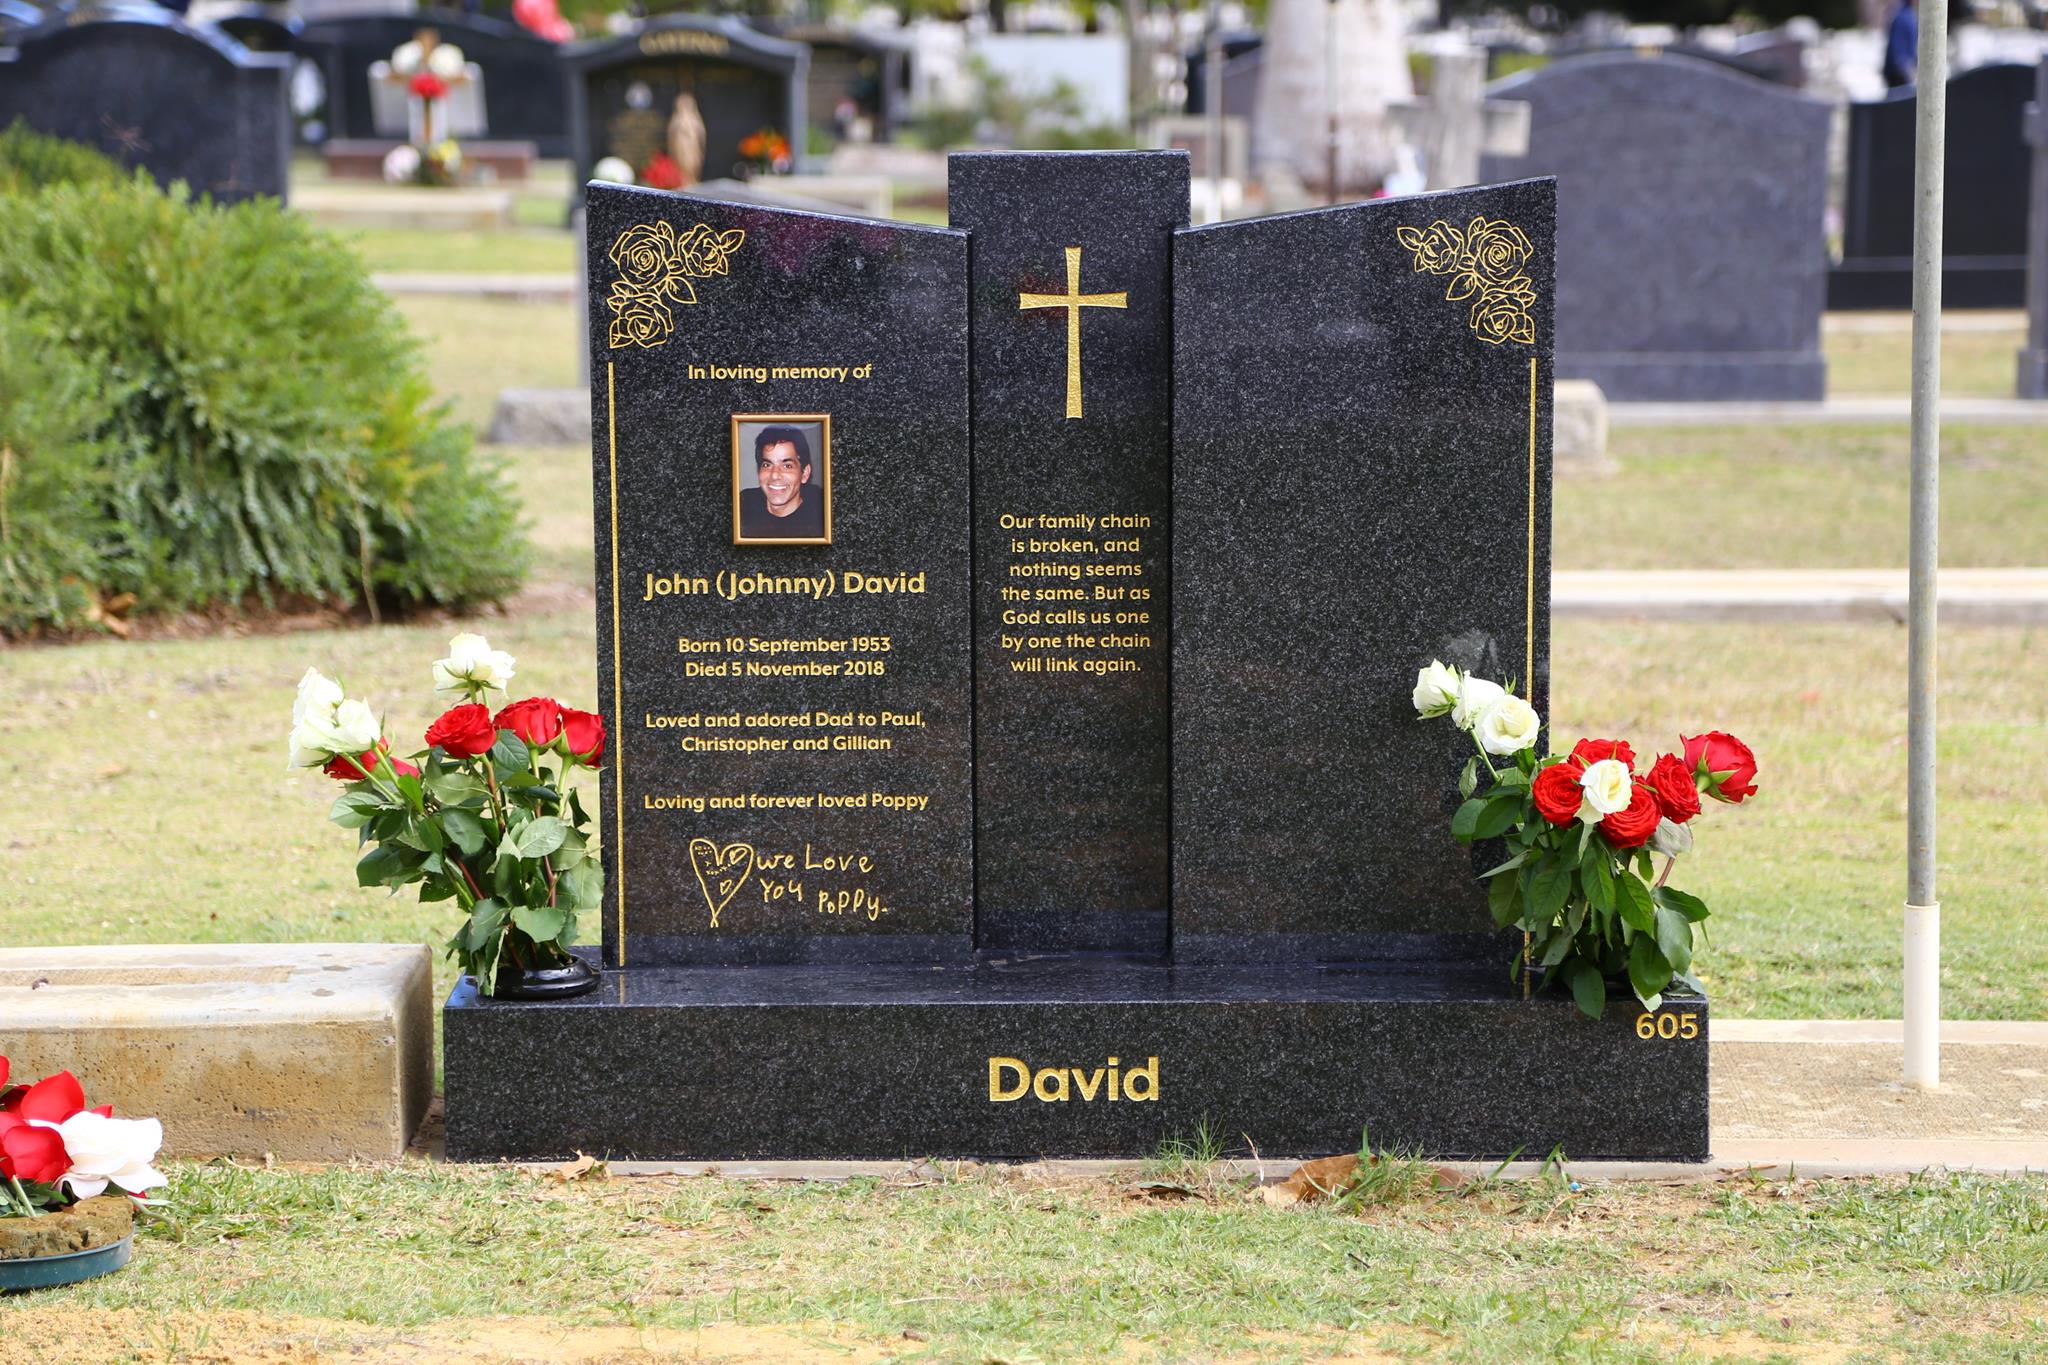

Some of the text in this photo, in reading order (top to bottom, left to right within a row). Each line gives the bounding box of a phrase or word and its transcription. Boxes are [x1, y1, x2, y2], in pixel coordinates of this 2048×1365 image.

[689, 363, 873, 383] In loving memory of
[999, 513, 1151, 532] Our family chain
[1011, 537, 1140, 554] is broken, and
[1009, 561, 1143, 581] nothing seems
[642, 568, 927, 601] John (Johnny) David
[1001, 585, 1151, 601] the same. But as
[1002, 609, 1150, 625] God calls us one
[677, 636, 892, 656] Born 10 September 1953
[1001, 633, 1151, 653] by one the chain
[685, 660, 886, 677] Died 5 November 2018
[1010, 656, 1142, 676] will link again.
[645, 710, 927, 729] Loved and adored Dad to Paul,
[681, 734, 892, 754] Christopher and Gillian
[643, 791, 929, 812] Loving and forever loved Poppy
[1635, 1011, 1699, 1040] 605
[987, 1055, 1161, 1102] David
